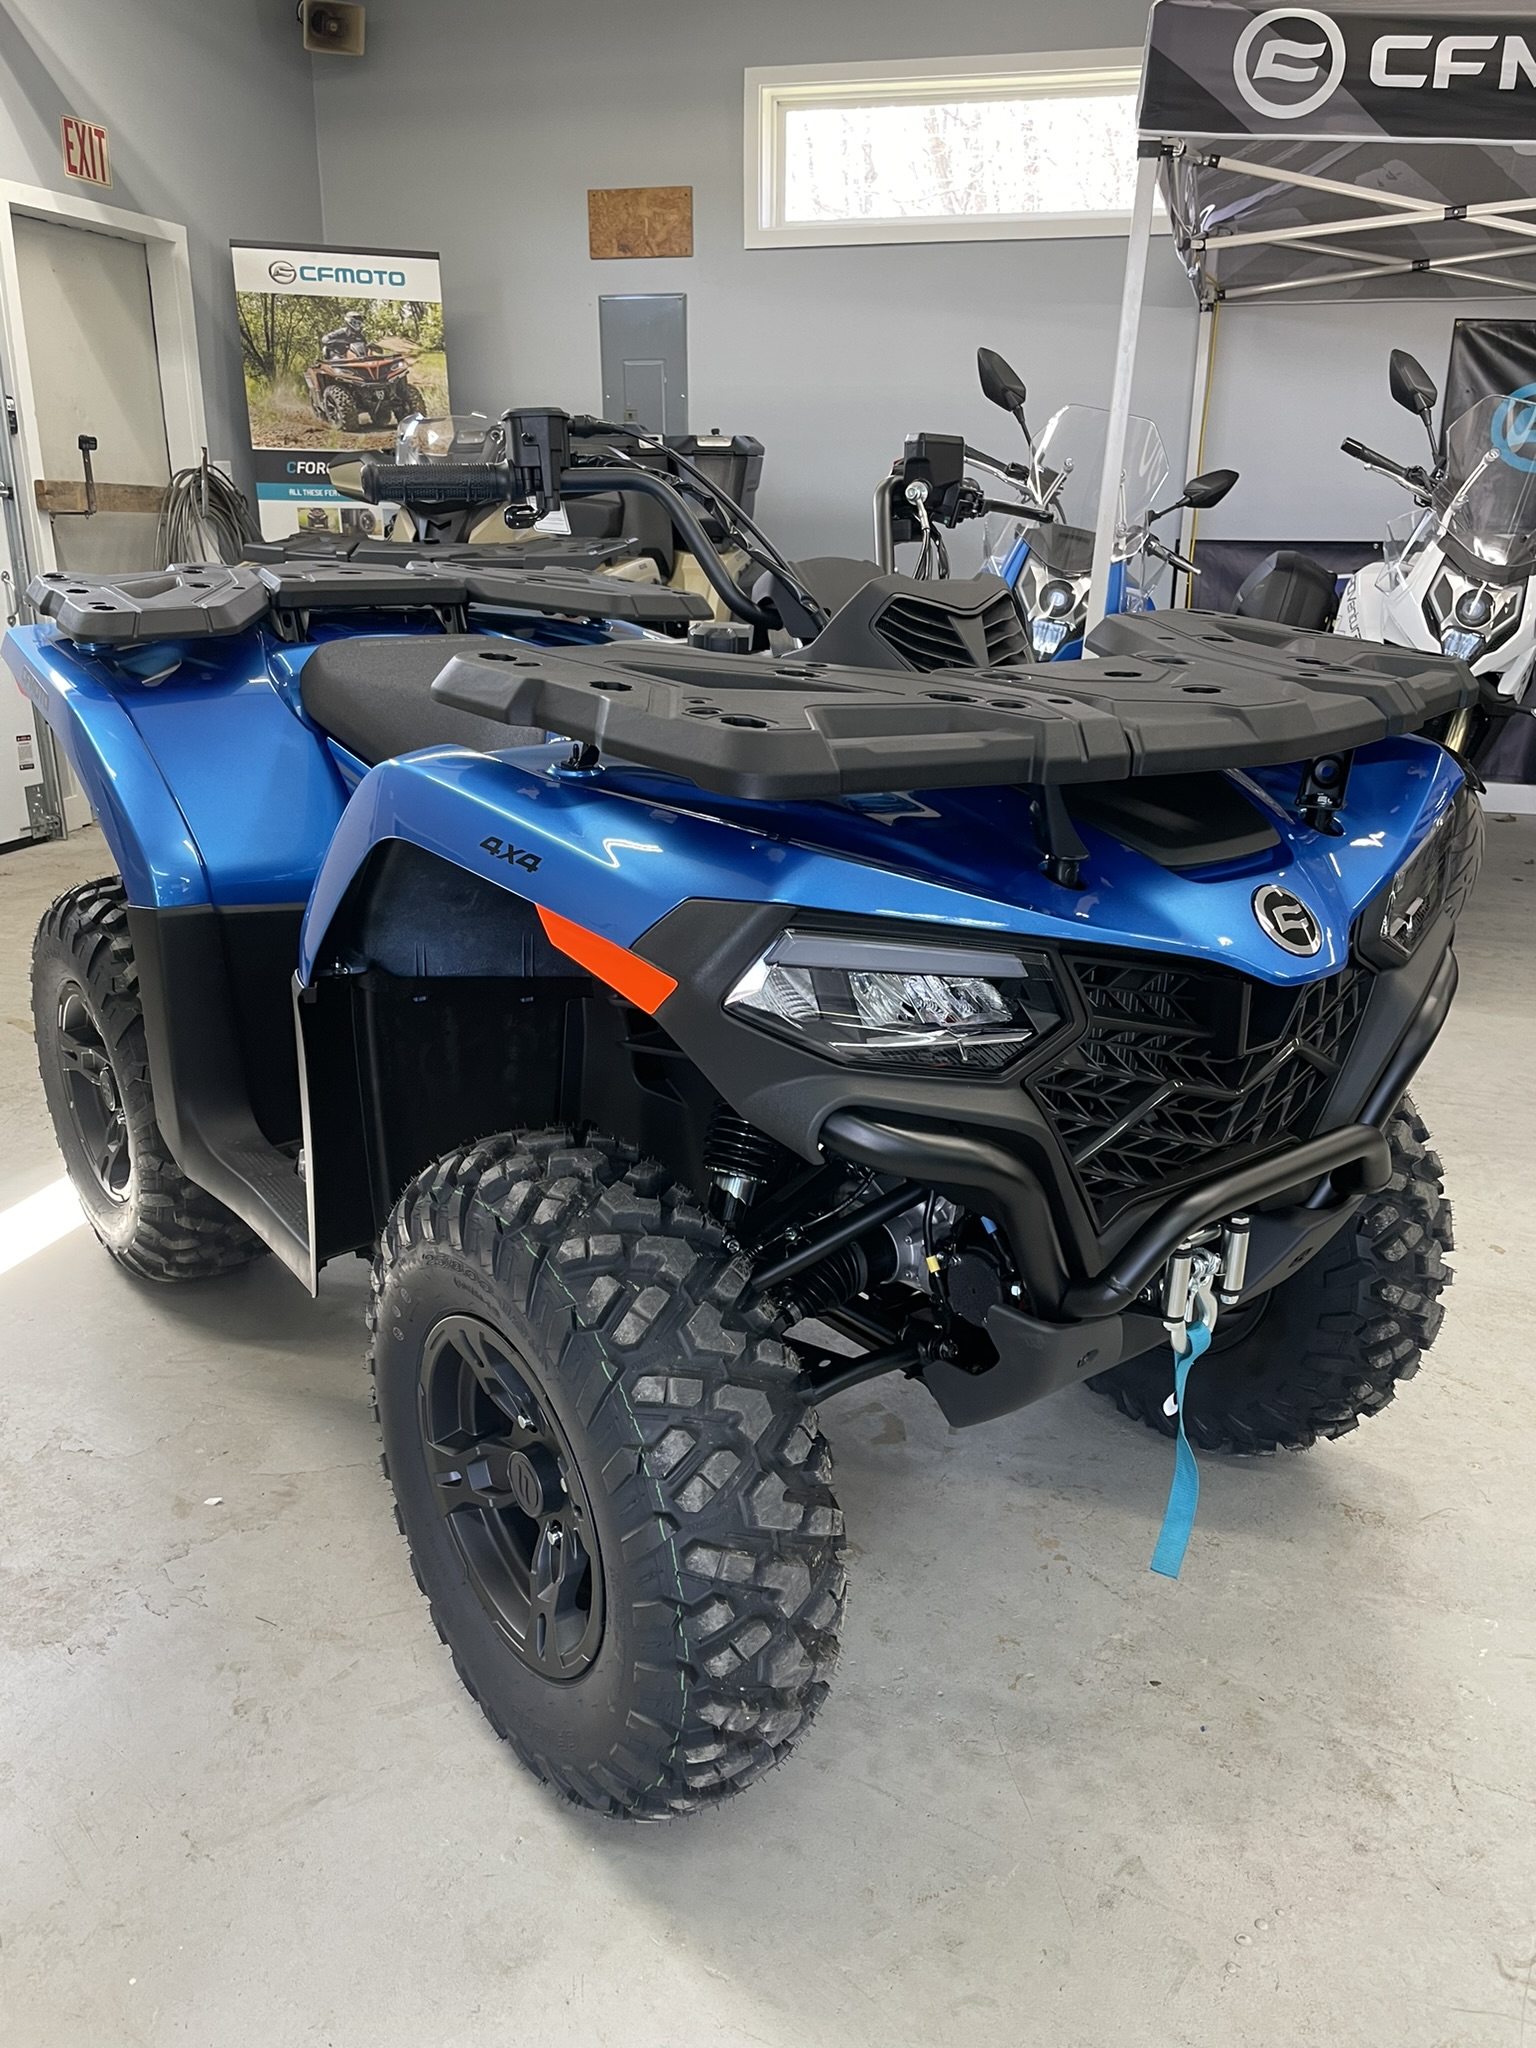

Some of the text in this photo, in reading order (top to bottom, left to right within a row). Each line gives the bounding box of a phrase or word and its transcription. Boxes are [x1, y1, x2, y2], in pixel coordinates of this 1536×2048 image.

[63, 118, 106, 182] EXIT
[299, 265, 406, 287] CFMOTO
[286, 461, 331, 475] CFOR
[289, 488, 341, 497] ALL THESE FEA
